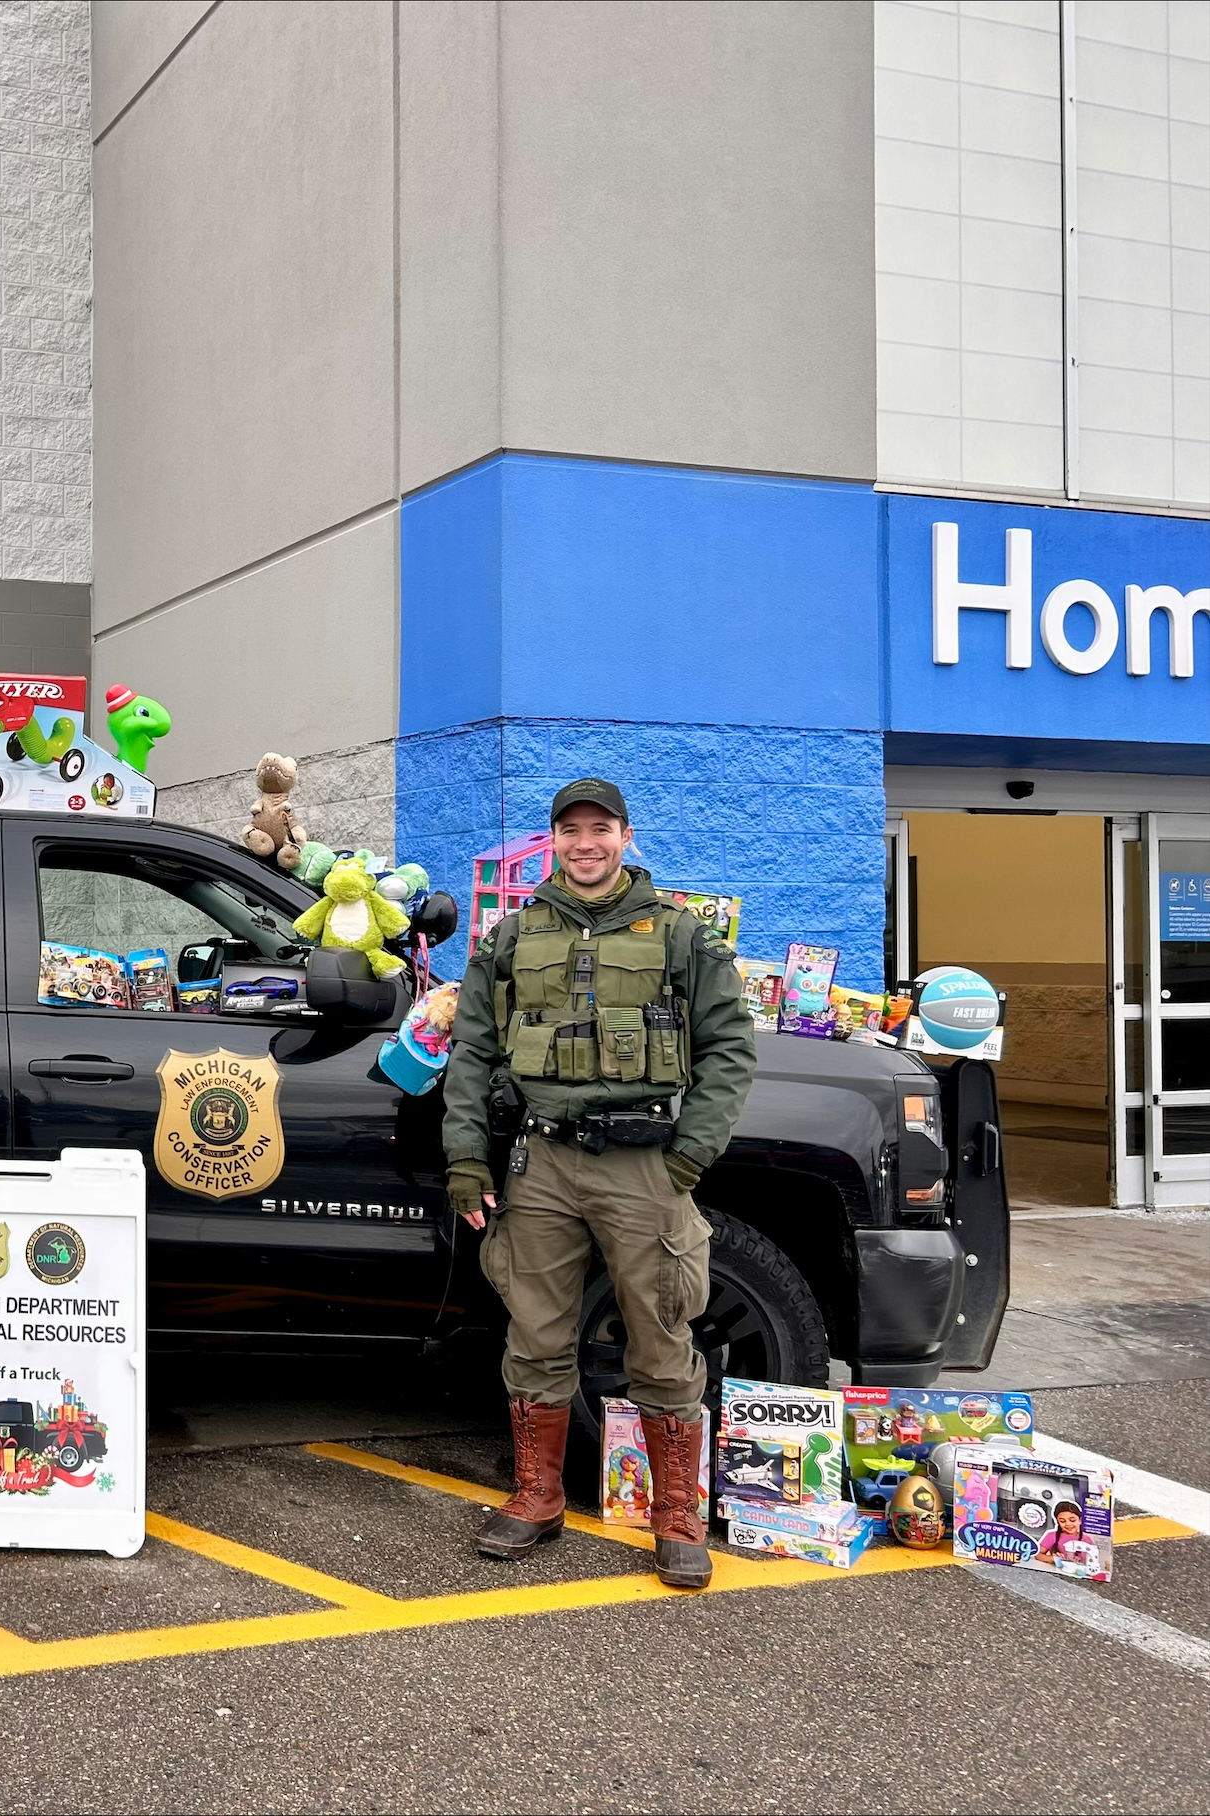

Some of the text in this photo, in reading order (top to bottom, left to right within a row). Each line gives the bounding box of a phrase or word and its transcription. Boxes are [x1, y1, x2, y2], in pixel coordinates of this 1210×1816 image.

[953, 1006, 974, 1018] FAST
[983, 1042, 997, 1051] FEEL
[173, 1060, 266, 1092] MICHIGAN
[181, 1077, 259, 1114] LAW ENFORCEMENT
[168, 1131, 272, 1175] CONSERVATION
[184, 1170, 254, 1190] OFFICER
[261, 1199, 424, 1219] SILVERADO
[26, 1230, 40, 1270] DEPARTMENT
[48, 1223, 74, 1235] NATURAL
[74, 1233, 85, 1271] RESOURCES
[36, 1254, 57, 1263] DNR
[41, 1275, 69, 1284] MICHIGAN
[6, 1297, 119, 1317] DEPARTMENT
[22, 1324, 126, 1344] RESOURCES
[9, 1370, 17, 1379] a
[20, 1367, 61, 1380] Truck
[845, 1390, 887, 1400] fisher-price
[733, 1402, 831, 1424] SORRY!
[729, 1441, 752, 1449] CREATOR
[8, 1475, 14, 1484] a
[16, 1471, 40, 1484] Truck
[743, 1509, 810, 1532] CANDY LAND
[963, 1526, 1038, 1562] Sewing
[976, 1548, 1021, 1563] MACHINE
